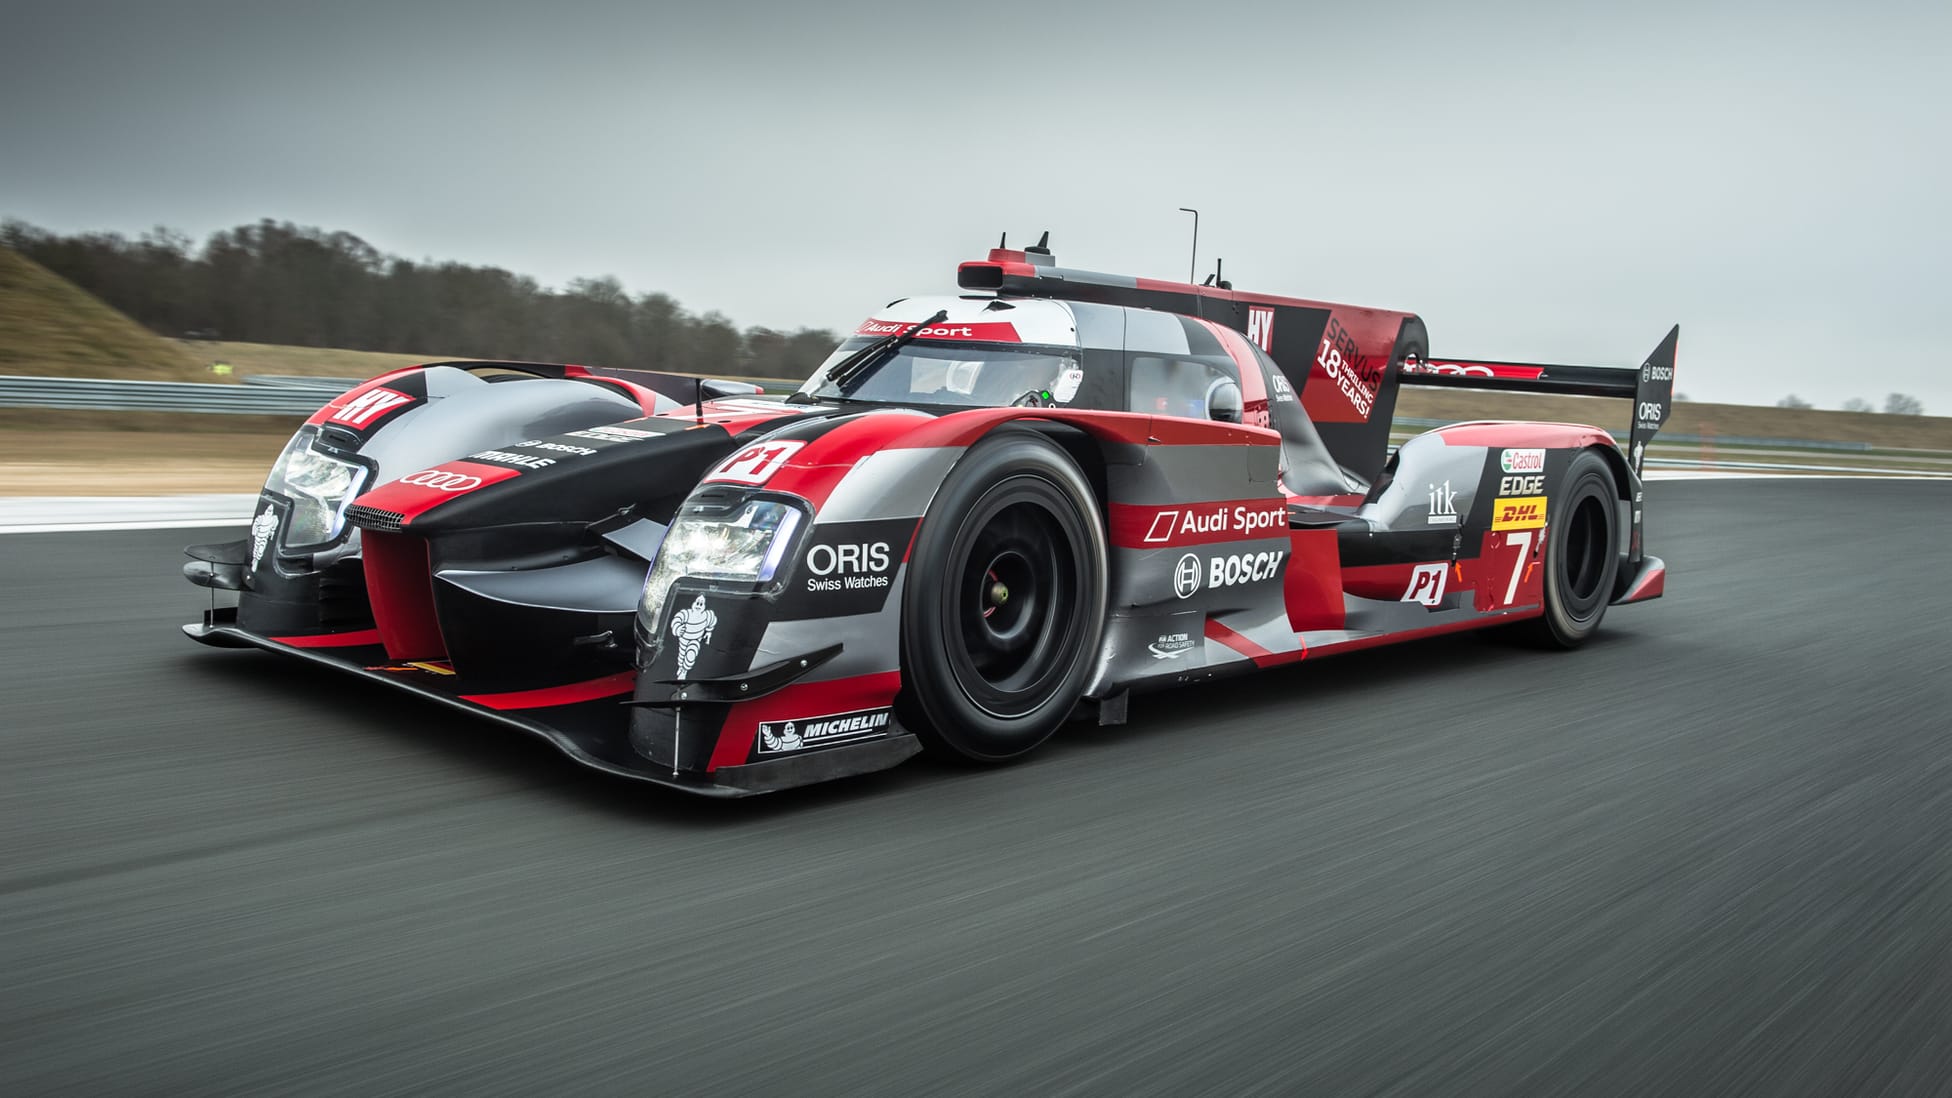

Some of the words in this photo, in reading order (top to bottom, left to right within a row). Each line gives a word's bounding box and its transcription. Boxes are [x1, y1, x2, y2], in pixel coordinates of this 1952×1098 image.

[866, 323, 902, 333] Audi
[1247, 309, 1274, 352] HY
[1327, 318, 1381, 392] SERVUS
[1317, 339, 1341, 379] 18
[1341, 360, 1374, 404] THRILLING
[1651, 366, 1673, 381] BOSCH
[332, 388, 411, 425] HY
[1337, 371, 1371, 419] YEARS!
[1639, 402, 1662, 421] ORIS
[470, 450, 557, 470] MAHLE
[535, 442, 597, 456] BOSCH
[719, 446, 786, 476] P1
[1512, 451, 1543, 470] Castrol
[1428, 480, 1458, 516] itk
[1499, 476, 1546, 496] EDGE
[1180, 508, 1228, 534] Audi
[1233, 506, 1286, 535] Sport
[1502, 505, 1539, 522] DHL
[806, 541, 890, 576] ORIS
[1208, 551, 1283, 589] BOSCH
[1503, 531, 1532, 605] 7
[807, 578, 842, 592] Swiss
[844, 575, 888, 589] Watches
[1409, 570, 1442, 600] P1
[1167, 633, 1188, 643] ACTION
[803, 712, 889, 739] MICHELIN
